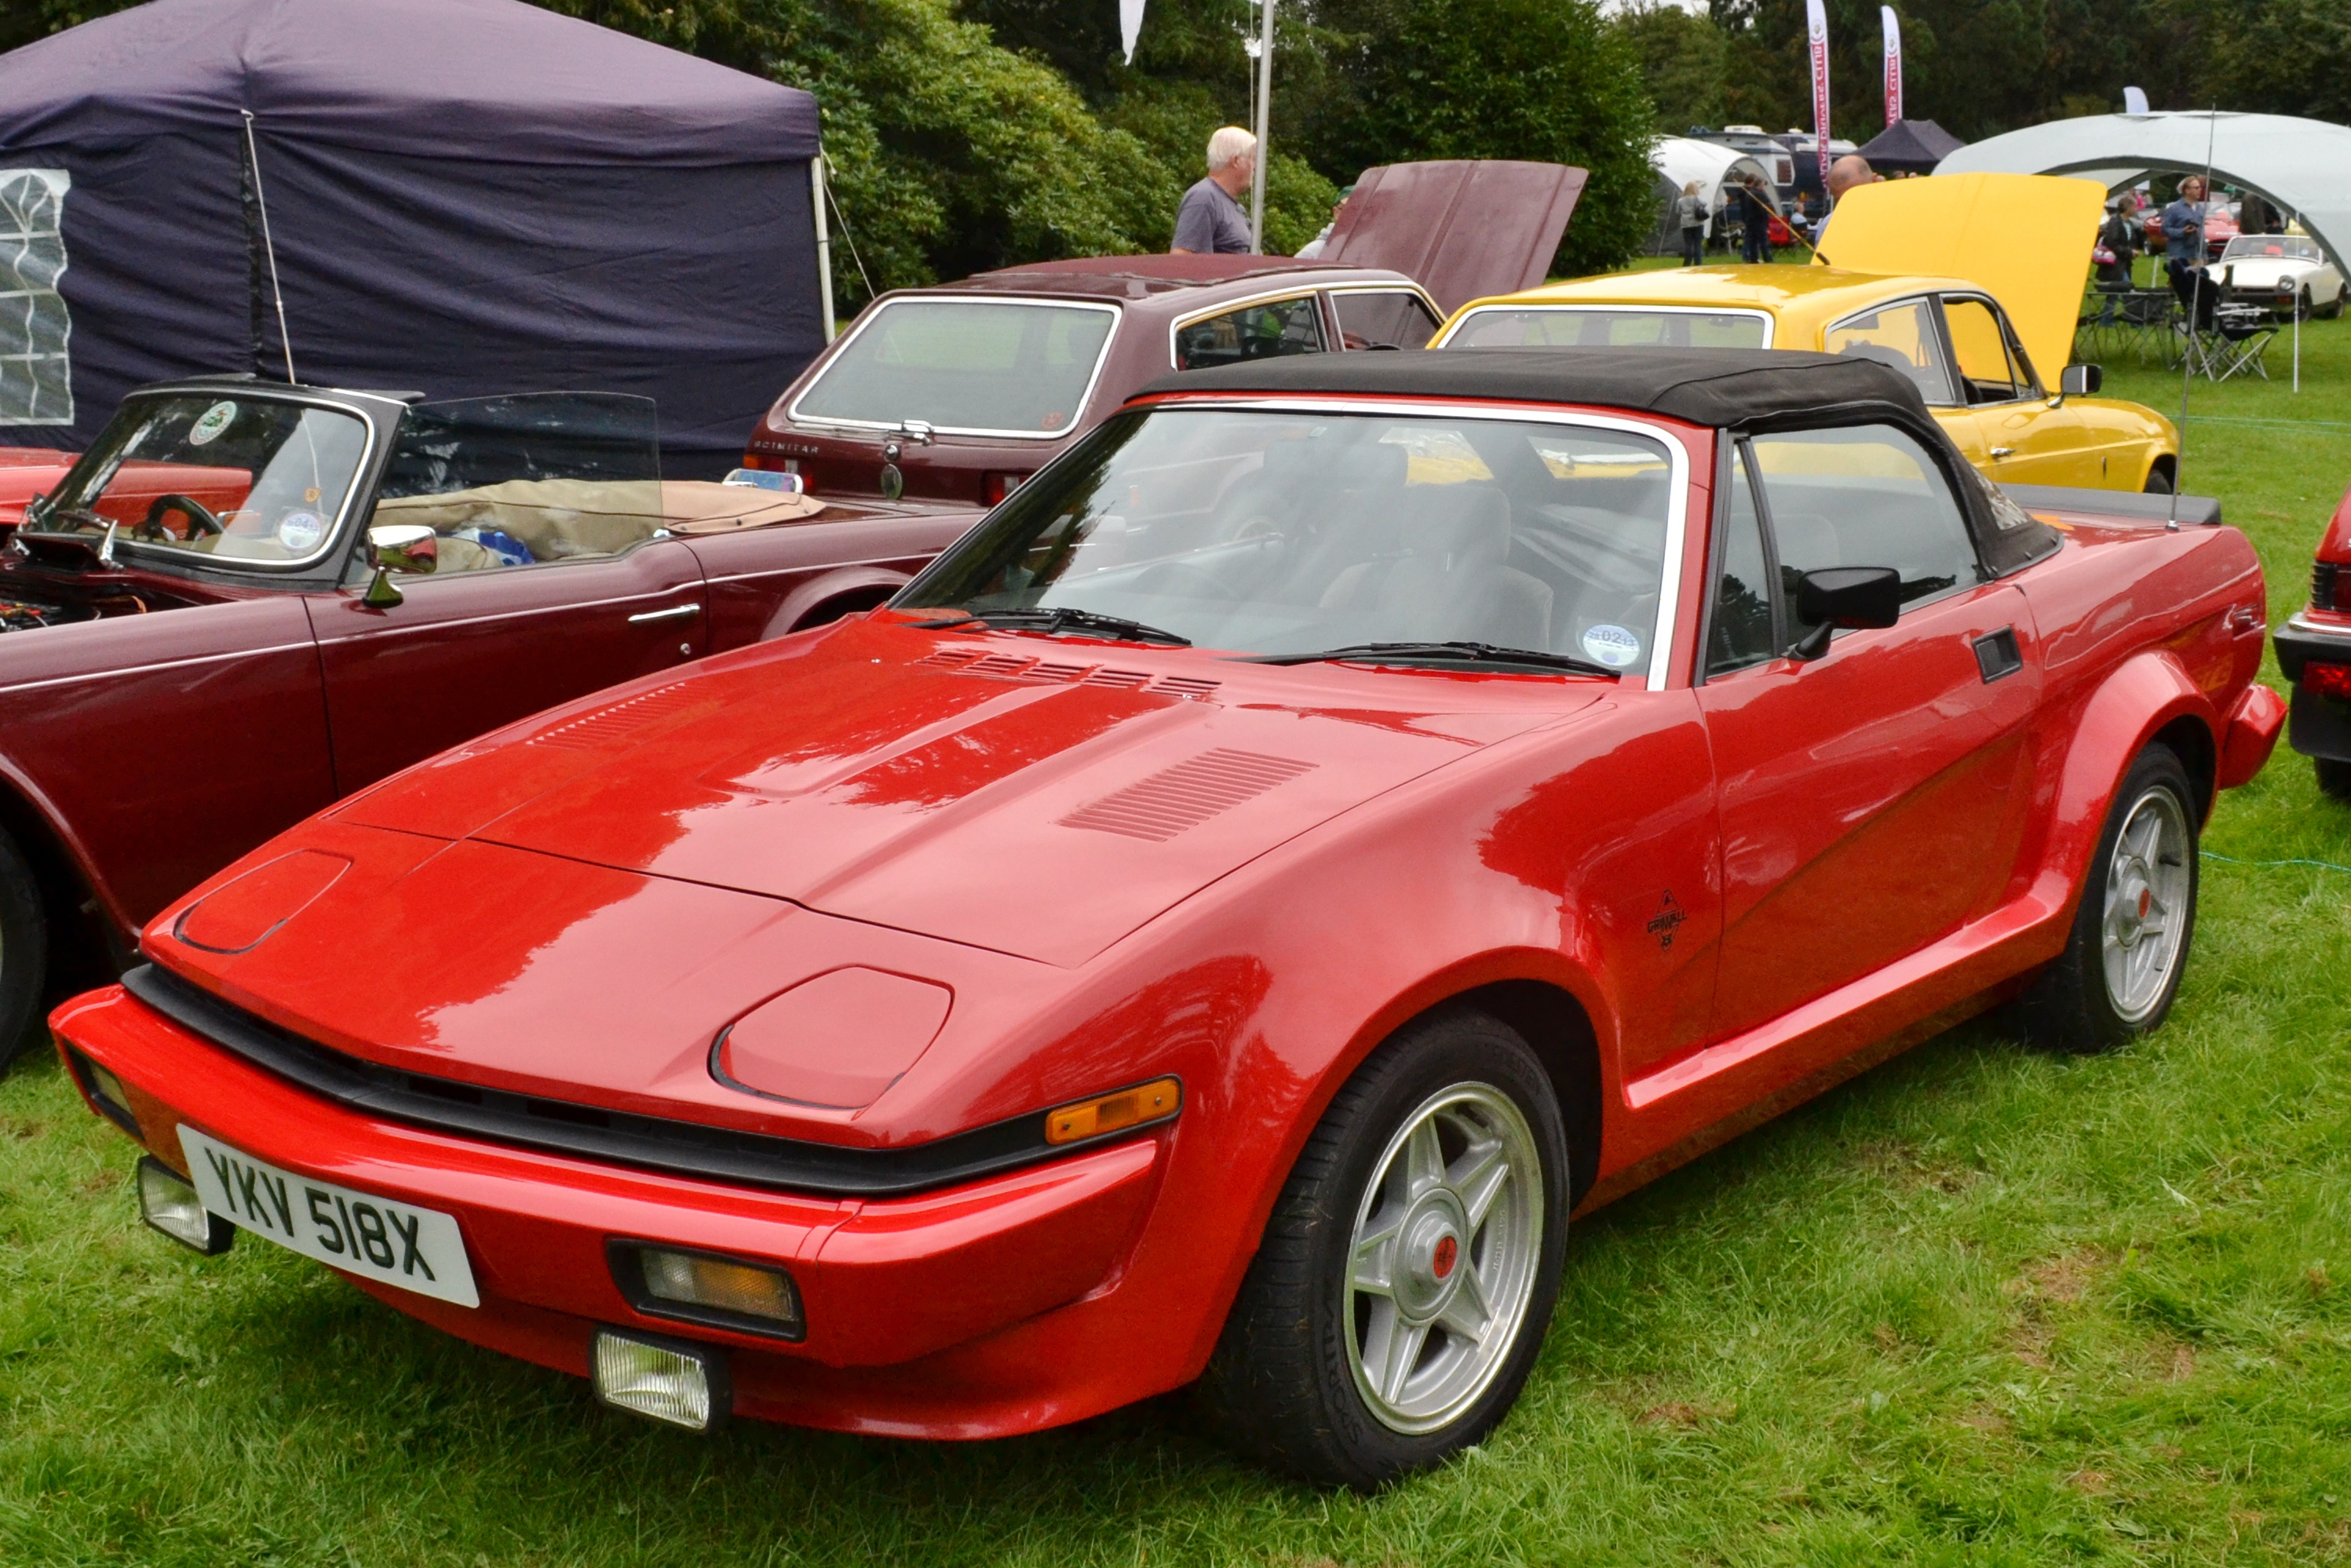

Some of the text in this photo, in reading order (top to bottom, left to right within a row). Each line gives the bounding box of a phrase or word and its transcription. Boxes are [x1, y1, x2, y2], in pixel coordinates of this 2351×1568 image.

[754, 440, 819, 454] SCIMITAR
[1601, 630, 1622, 644] 02
[204, 1147, 436, 1282] YKV 518X
